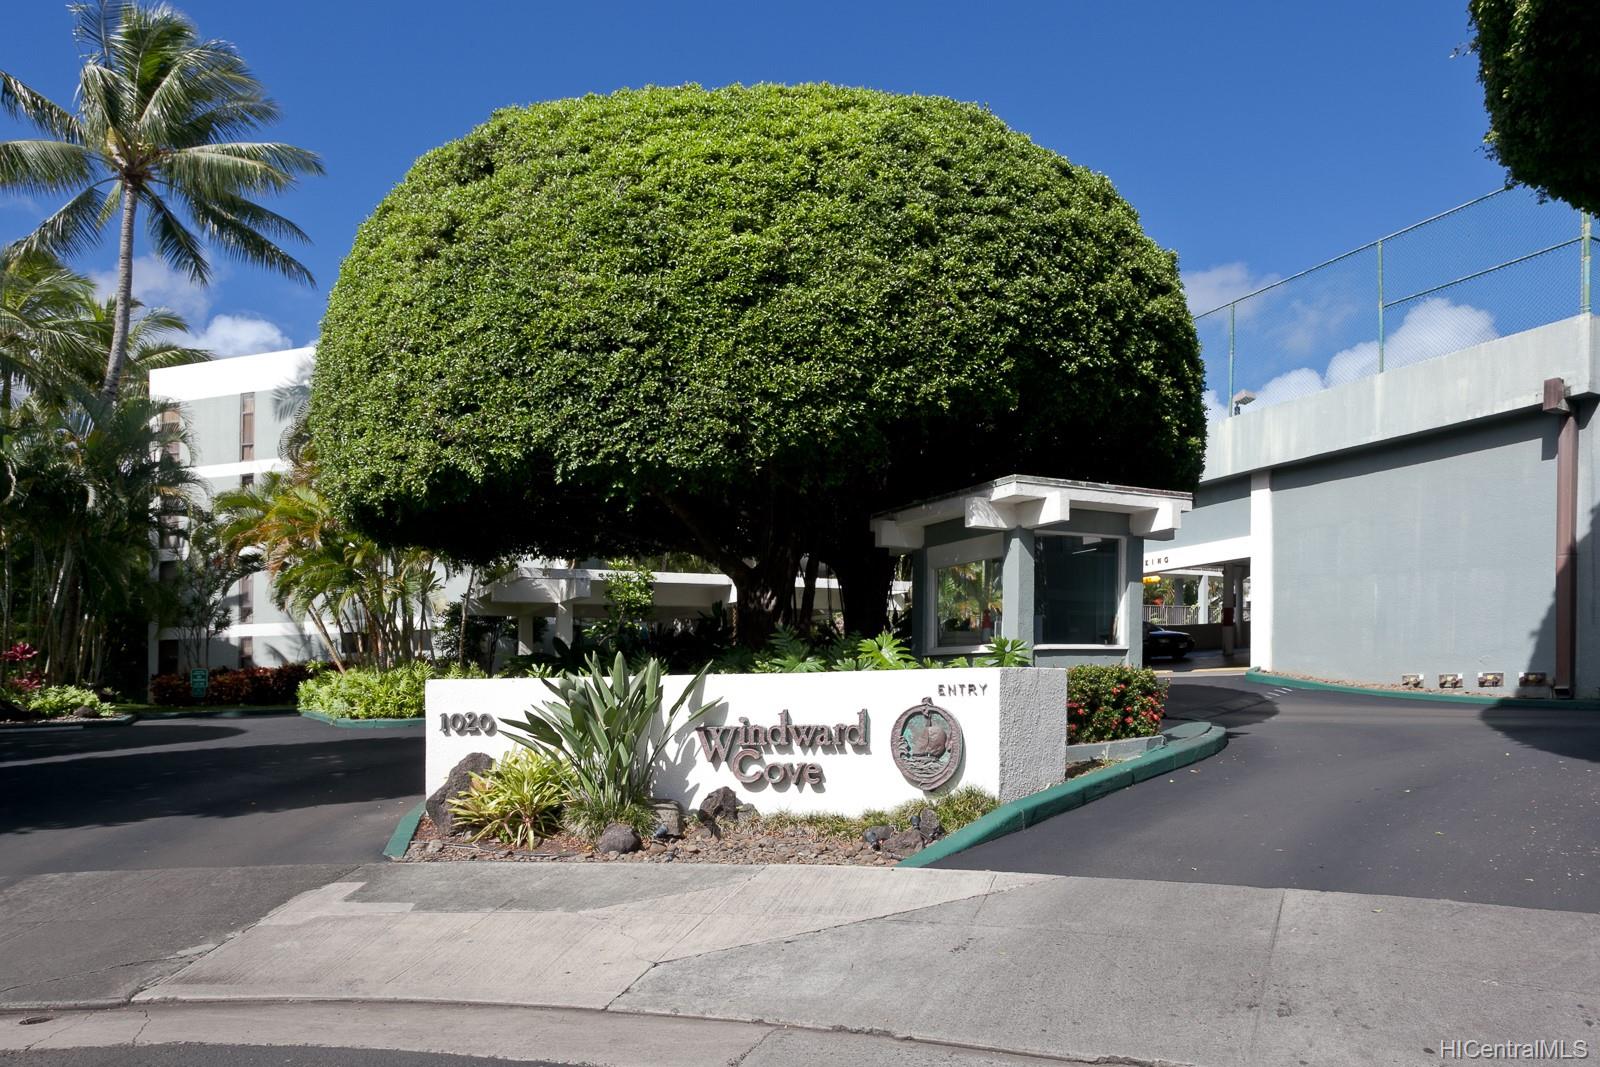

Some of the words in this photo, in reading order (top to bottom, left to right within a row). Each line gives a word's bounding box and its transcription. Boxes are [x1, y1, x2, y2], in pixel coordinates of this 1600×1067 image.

[937, 683, 988, 697] ENTRY
[440, 711, 494, 733] 1020
[696, 708, 868, 763] Windward
[732, 748, 822, 786] Cove
